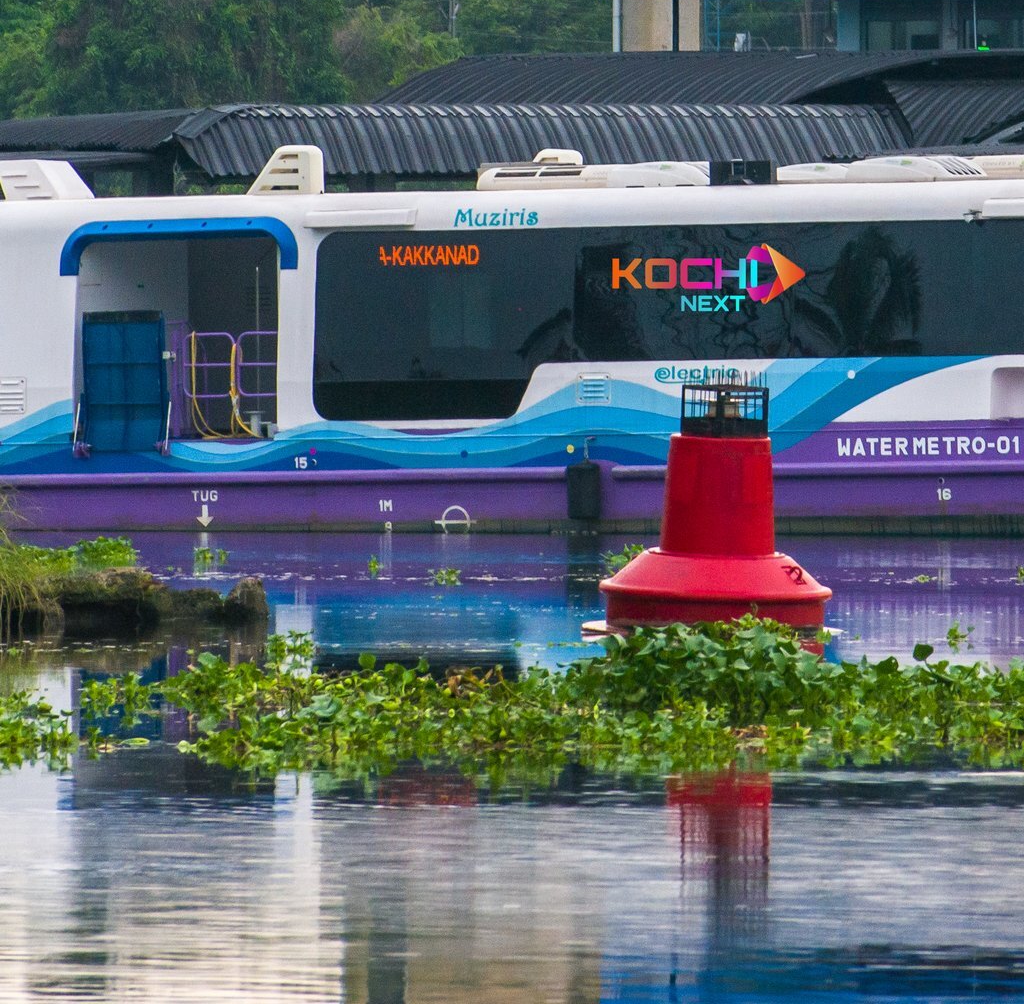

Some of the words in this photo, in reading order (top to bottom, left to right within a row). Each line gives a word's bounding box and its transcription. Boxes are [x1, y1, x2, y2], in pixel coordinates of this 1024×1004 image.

[453, 208, 539, 227] Muziris
[611, 258, 758, 289] KOCHI
[681, 295, 746, 312] NEXT
[294, 456, 308, 469] 15
[191, 490, 218, 502] TUG
[936, 488, 952, 501] 16
[379, 499, 393, 512] 1M
